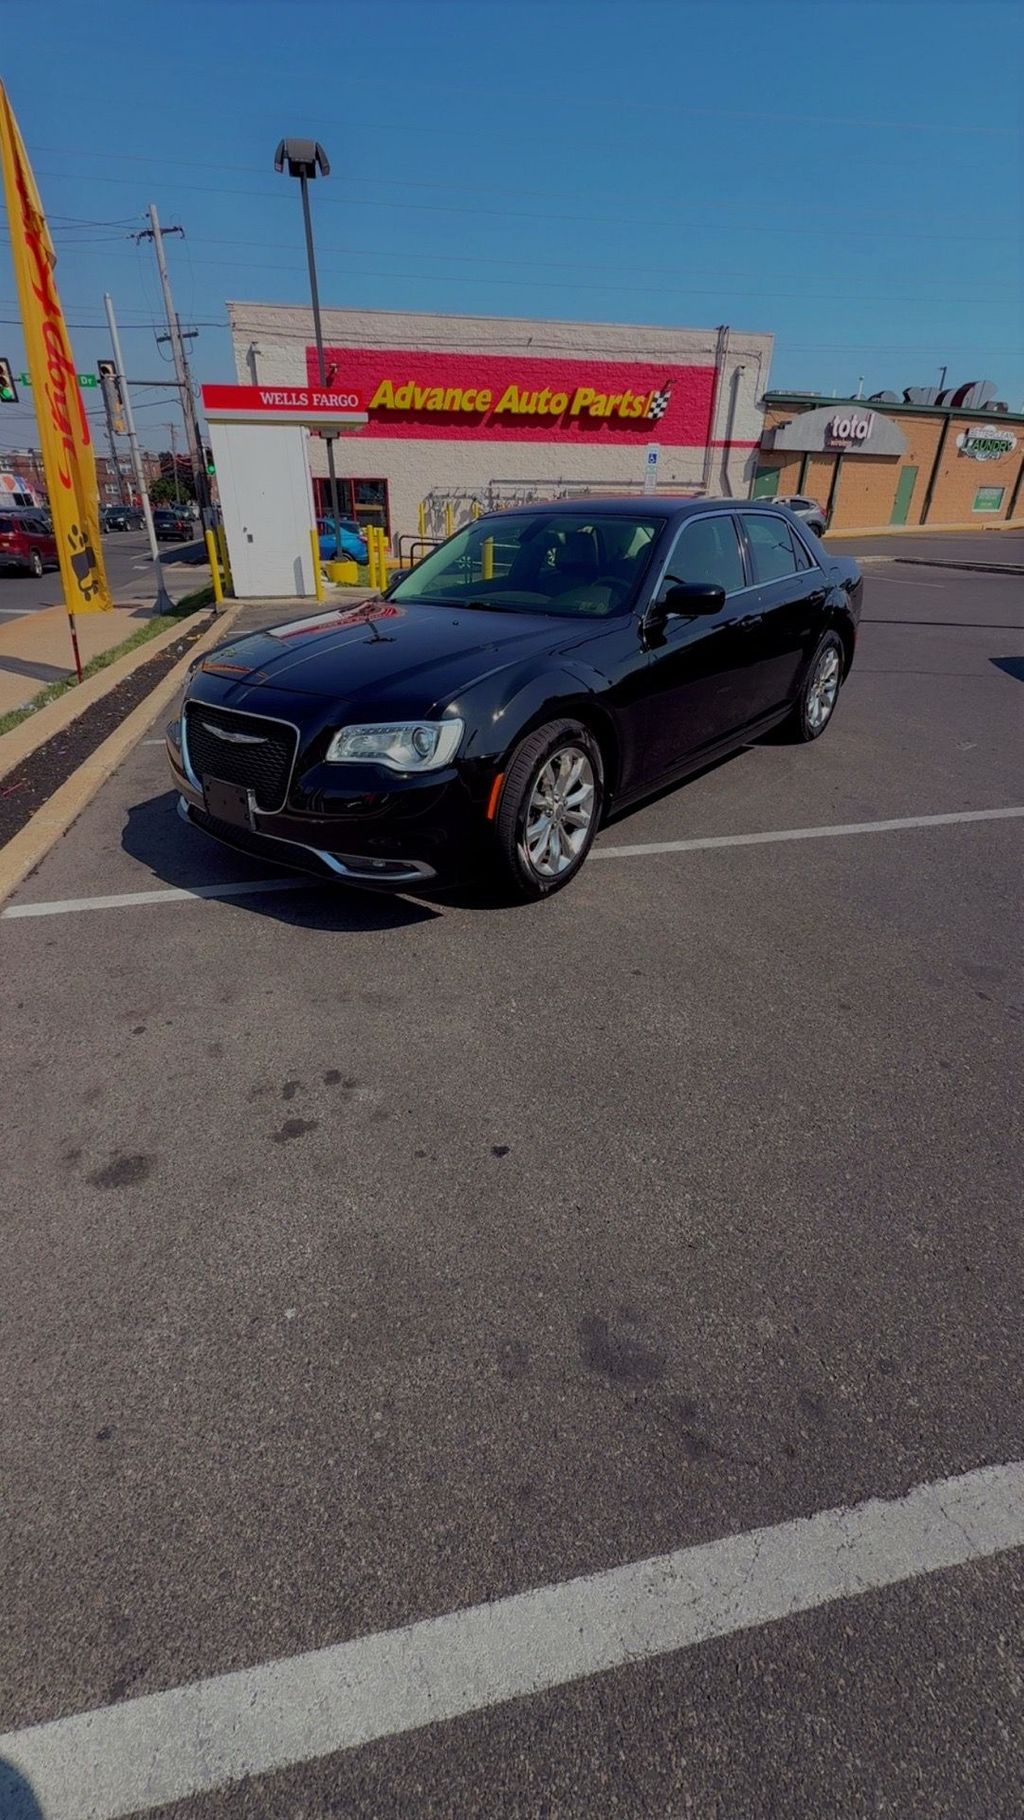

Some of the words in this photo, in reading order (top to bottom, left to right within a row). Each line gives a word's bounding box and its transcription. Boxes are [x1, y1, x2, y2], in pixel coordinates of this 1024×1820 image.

[80, 375, 92, 385] Dr
[259, 391, 309, 406] WELLS
[312, 393, 359, 407] FARGO
[368, 379, 492, 412] Advance
[494, 385, 569, 415] Auto
[569, 387, 643, 418] Parts
[832, 413, 876, 439] total
[961, 432, 1013, 452] LAUNDRY
